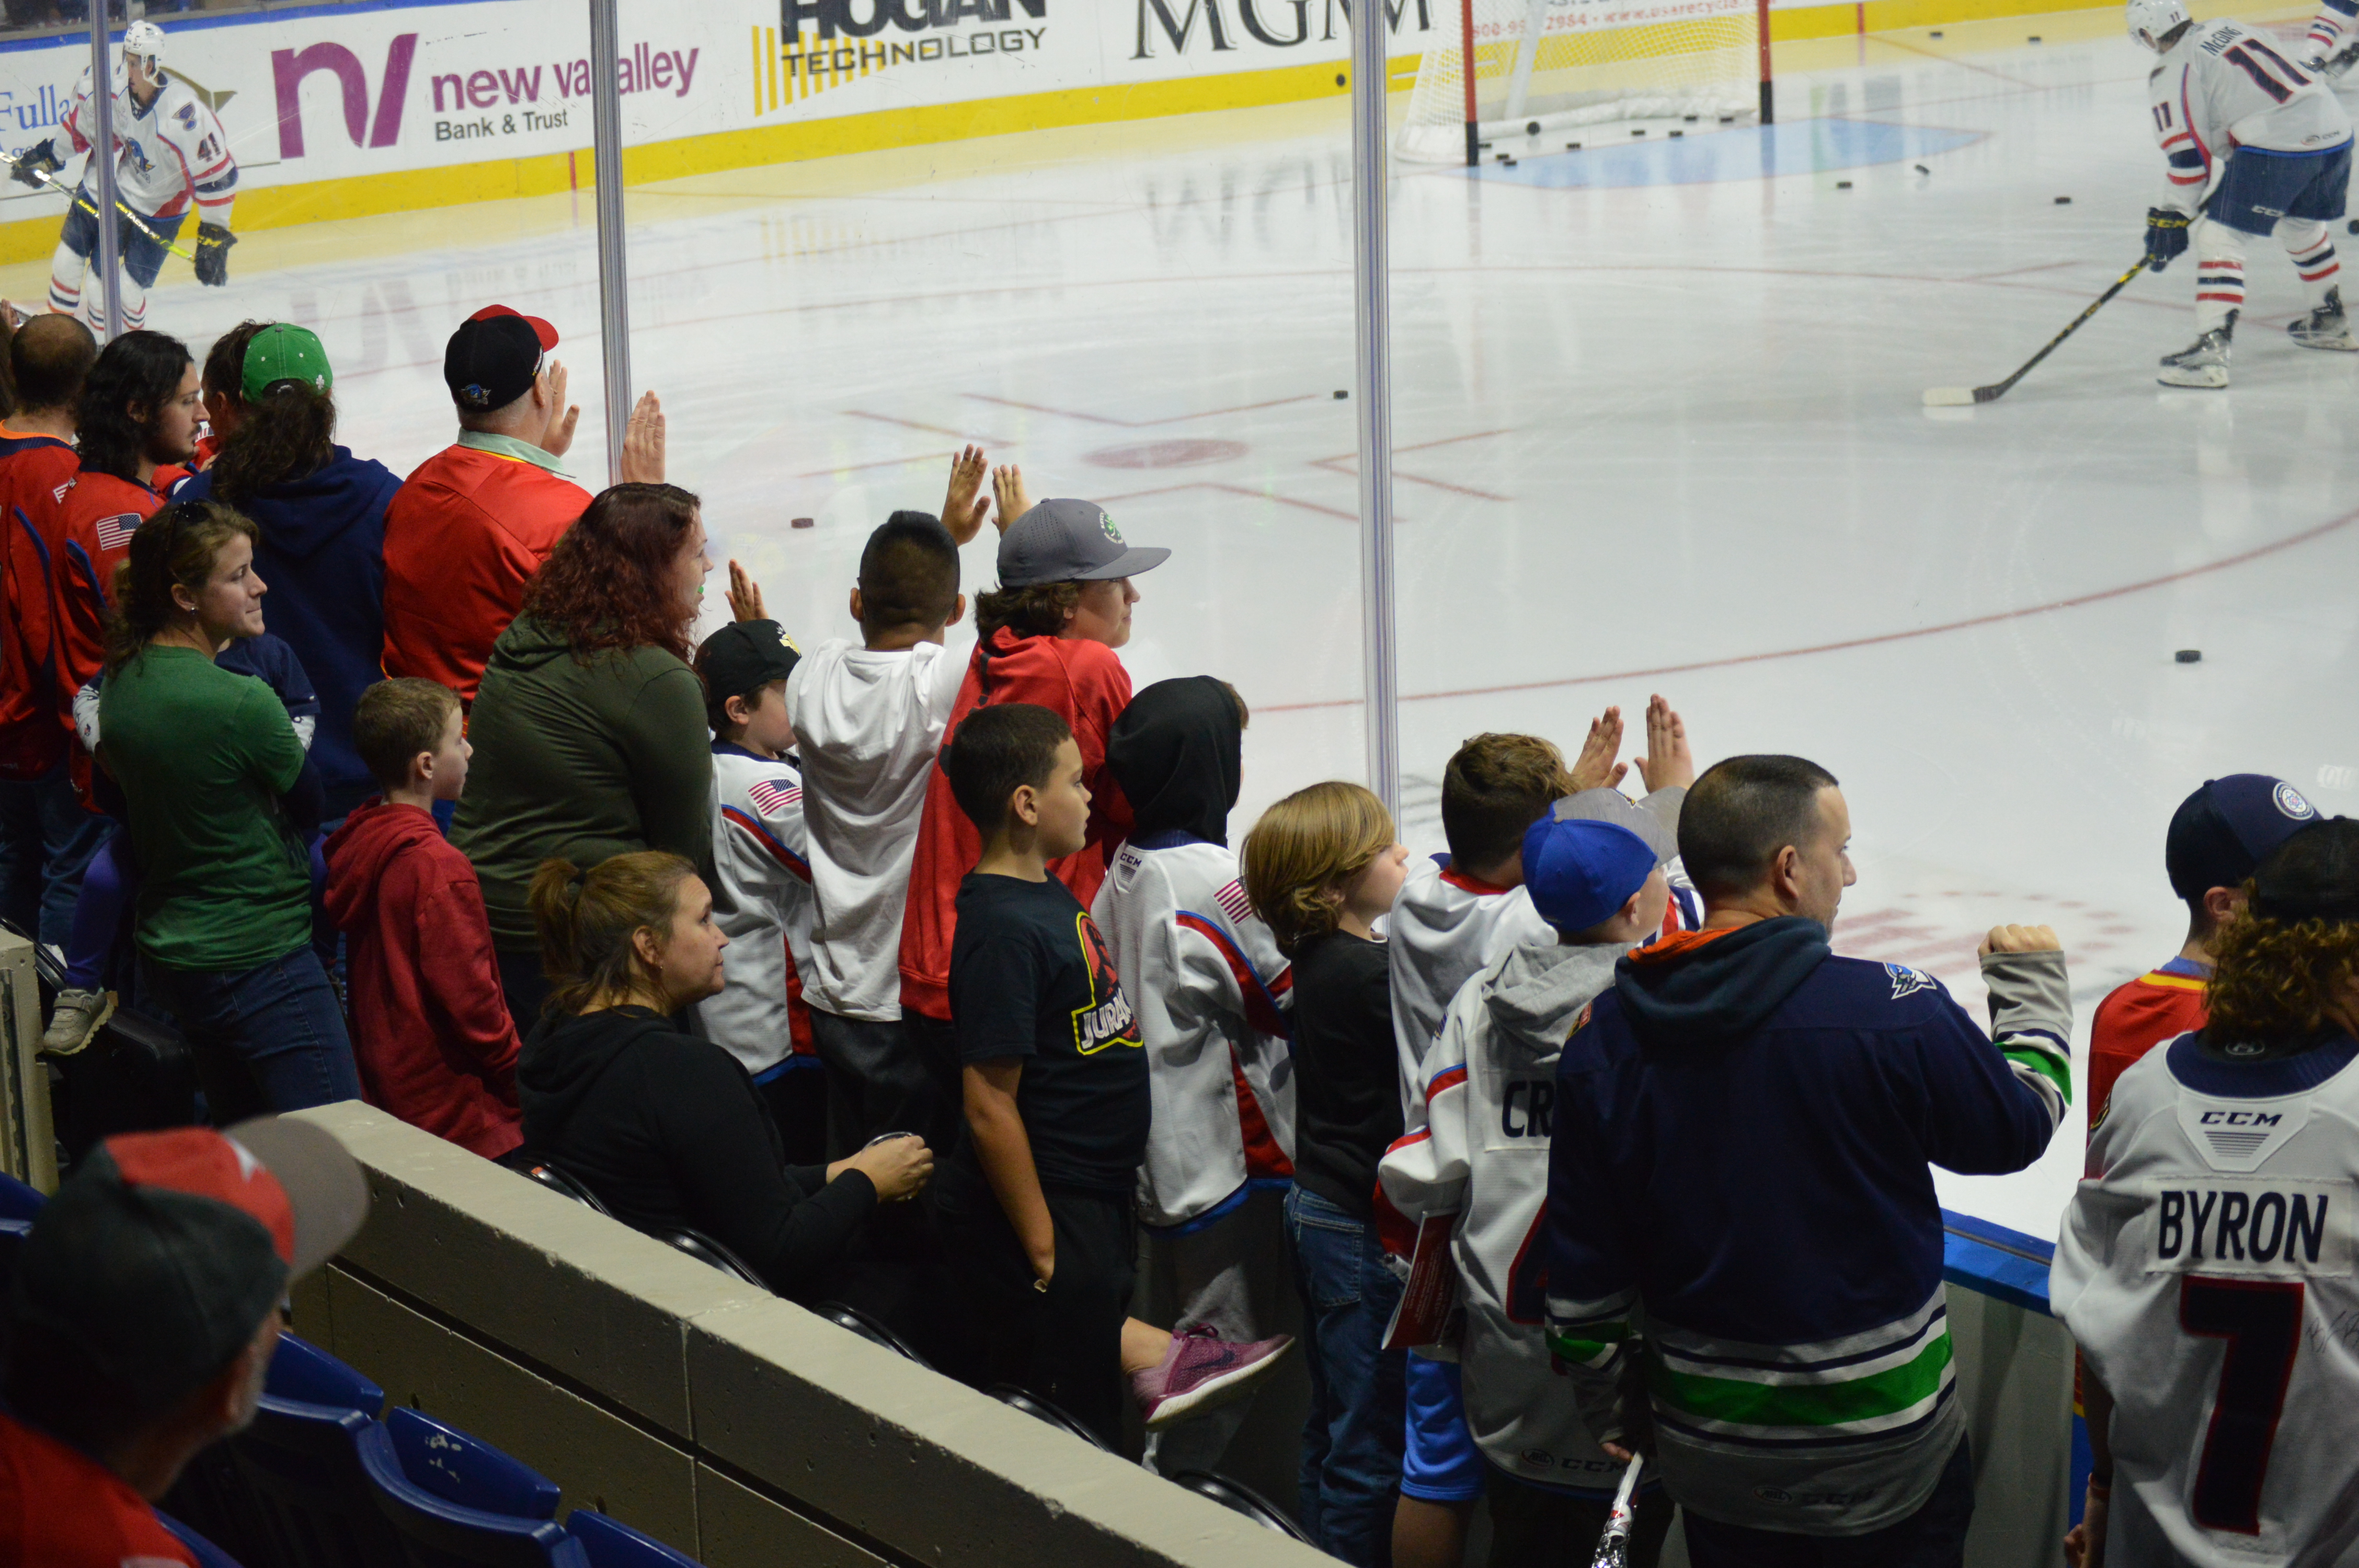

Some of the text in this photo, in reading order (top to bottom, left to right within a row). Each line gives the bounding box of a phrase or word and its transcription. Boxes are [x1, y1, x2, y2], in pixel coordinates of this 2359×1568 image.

[781, 27, 1047, 76] TECHNOLOGY
[2200, 26, 2243, 56] McGING
[2223, 38, 2312, 105] 11
[431, 65, 542, 112] new
[436, 109, 568, 142] Bank & Trust
[2151, 101, 2172, 132] 11
[197, 132, 221, 163] 41
[1120, 852, 1142, 868] CCM
[2200, 1111, 2283, 1127] CCM
[2158, 1191, 2329, 1263] BYRON
[2180, 1274, 2305, 1537] 7
